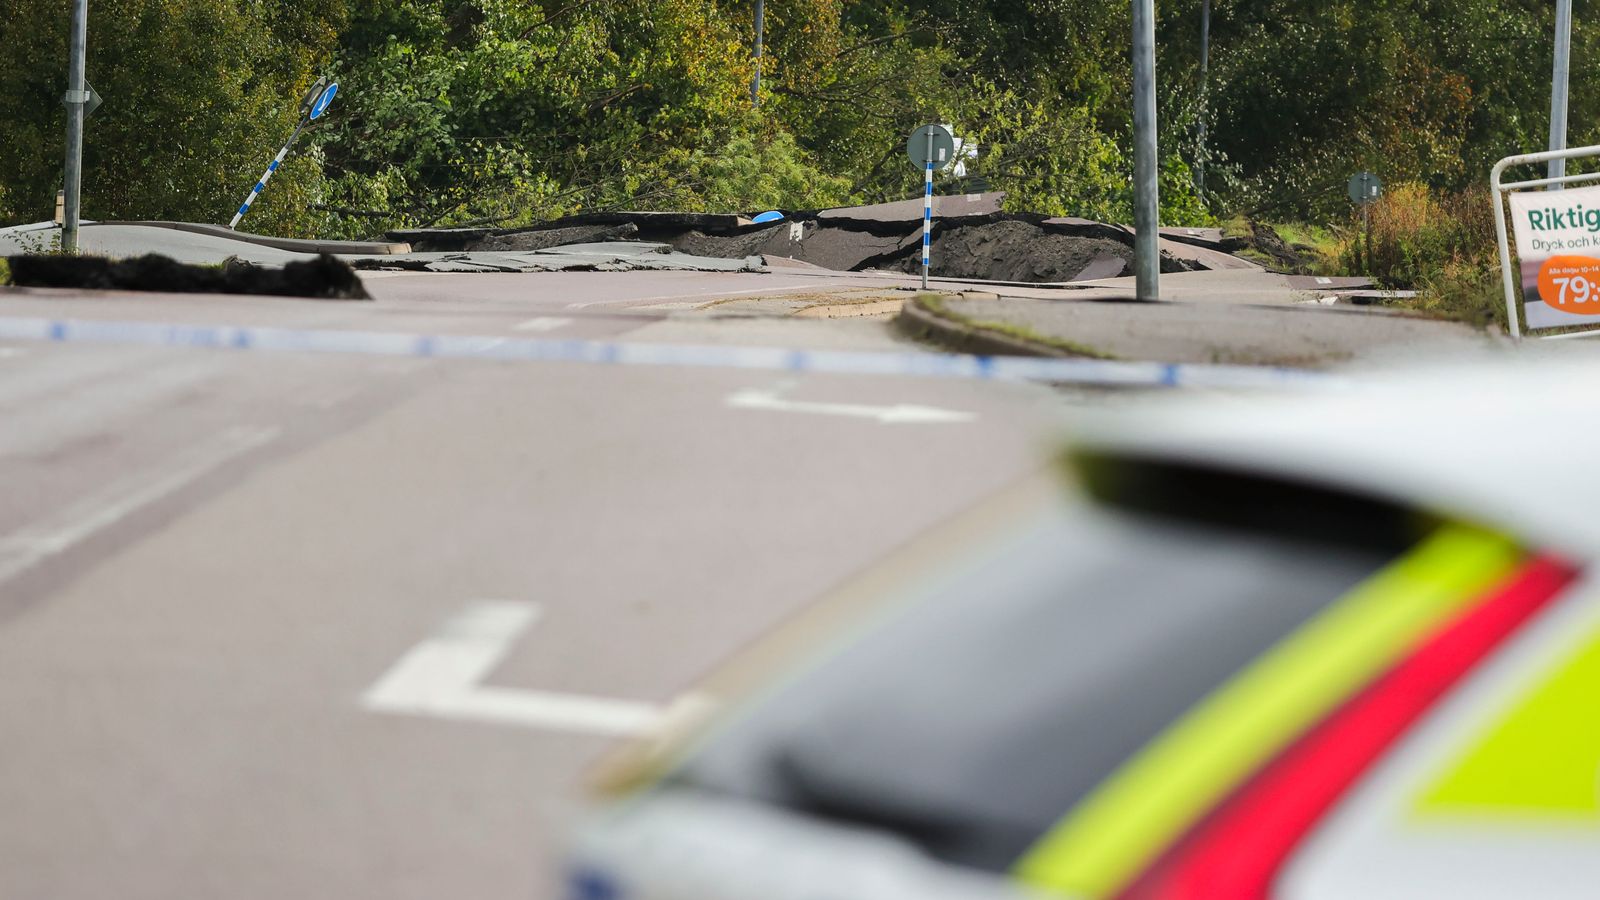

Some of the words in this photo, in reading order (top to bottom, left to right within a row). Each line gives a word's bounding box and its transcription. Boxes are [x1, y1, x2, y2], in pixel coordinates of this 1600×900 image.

[1528, 204, 1600, 232] Riktig
[1532, 239, 1566, 251] Dryck
[1567, 236, 1590, 248] och
[1592, 235, 1600, 246] k
